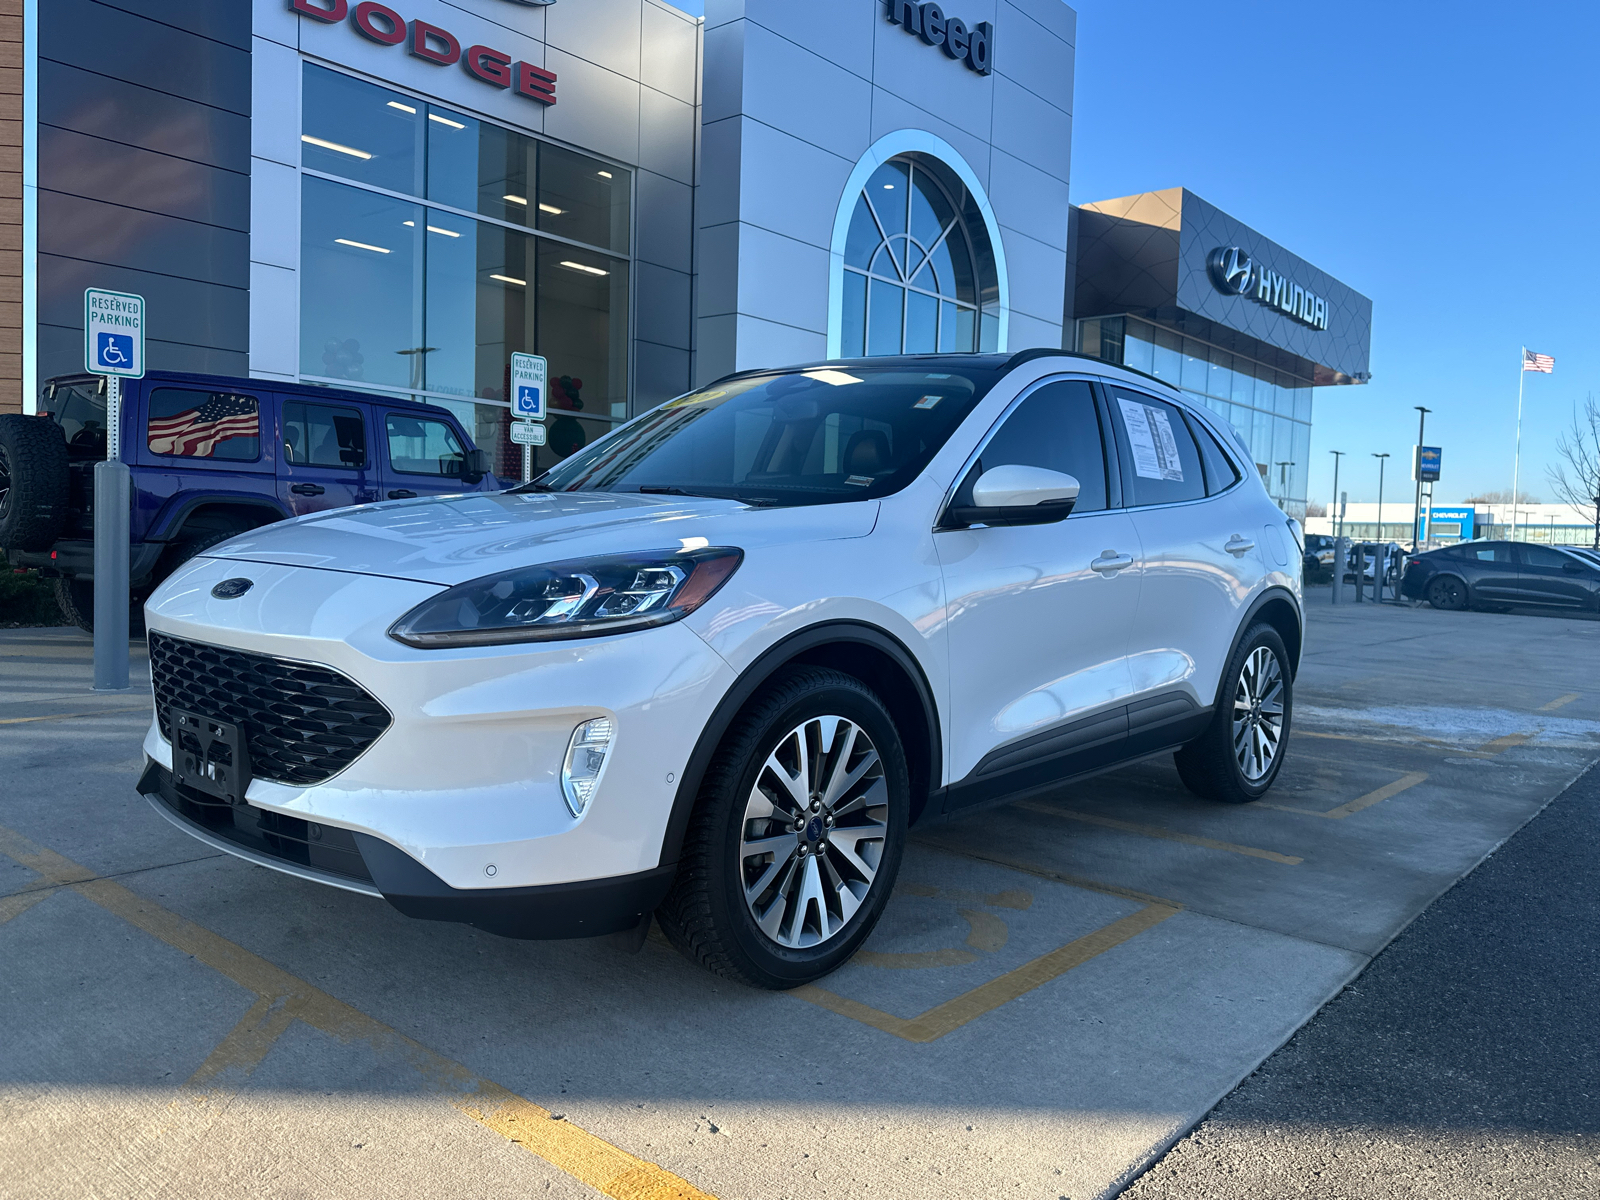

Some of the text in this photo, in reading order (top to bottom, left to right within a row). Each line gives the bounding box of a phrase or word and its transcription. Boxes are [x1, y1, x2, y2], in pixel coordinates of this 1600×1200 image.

[1258, 264, 1329, 331] HYUNDAI
[91, 297, 139, 314] RESERVED
[91, 311, 139, 328] PARKING
[515, 359, 543, 371] RESERVED
[515, 370, 543, 382] PARKING
[514, 432, 543, 442] ACCESSIBLE
